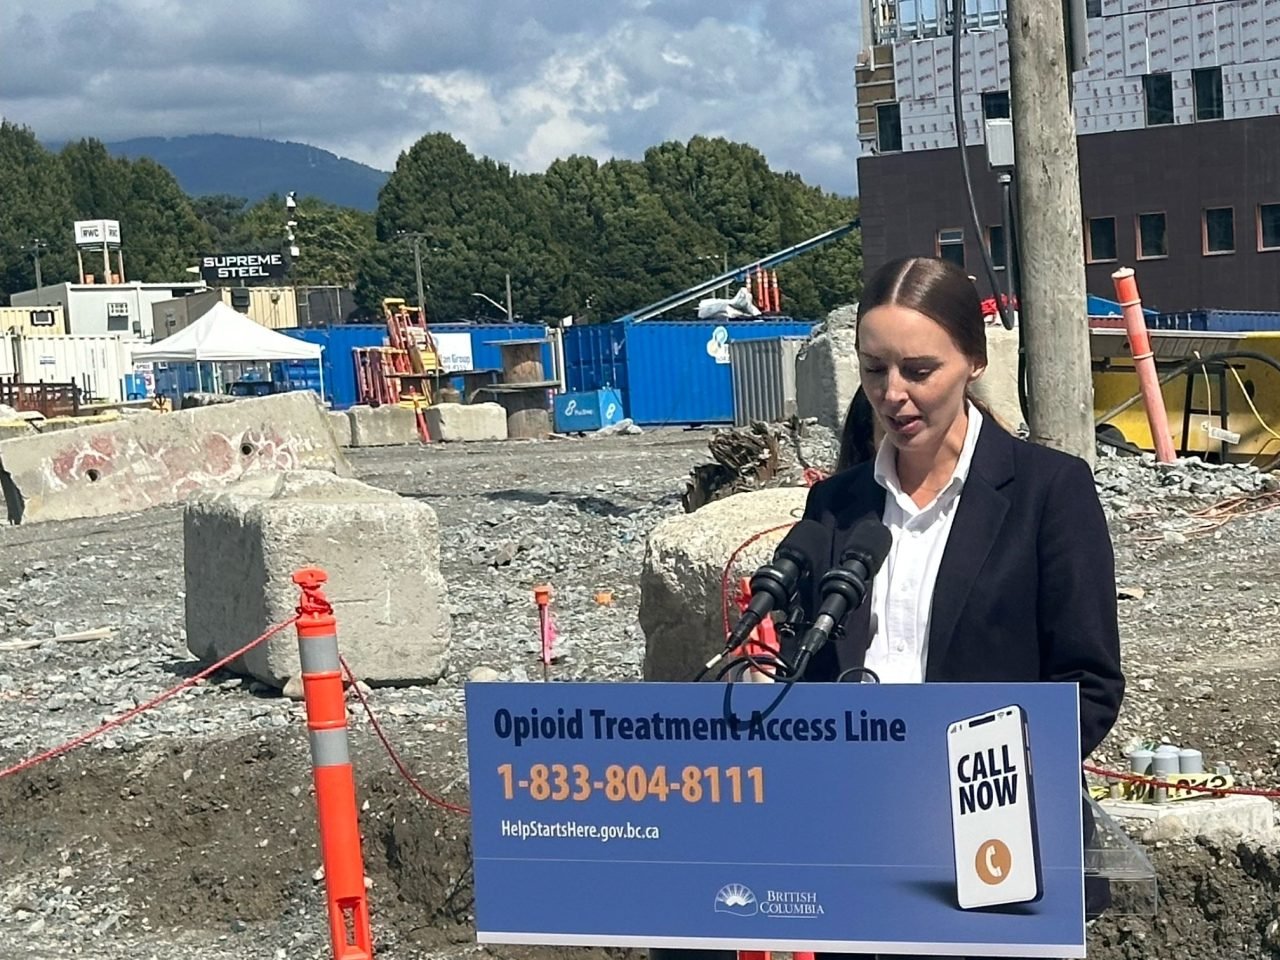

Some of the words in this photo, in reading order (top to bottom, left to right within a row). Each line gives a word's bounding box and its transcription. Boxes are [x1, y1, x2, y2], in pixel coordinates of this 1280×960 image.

[204, 254, 282, 267] SUPREME
[218, 266, 269, 278] STEEL
[494, 708, 583, 747] Opioid
[590, 708, 741, 741] Treatment
[748, 710, 837, 741] Access
[845, 709, 906, 742] Line
[957, 744, 1016, 784] CALL
[497, 764, 765, 804] 1-833-804-8111
[959, 774, 1018, 815] NOW
[502, 820, 659, 842] HelpStartsHere.gov.bc.ca
[760, 901, 825, 914] COLUMBIA
[767, 890, 817, 903] BRITISH
